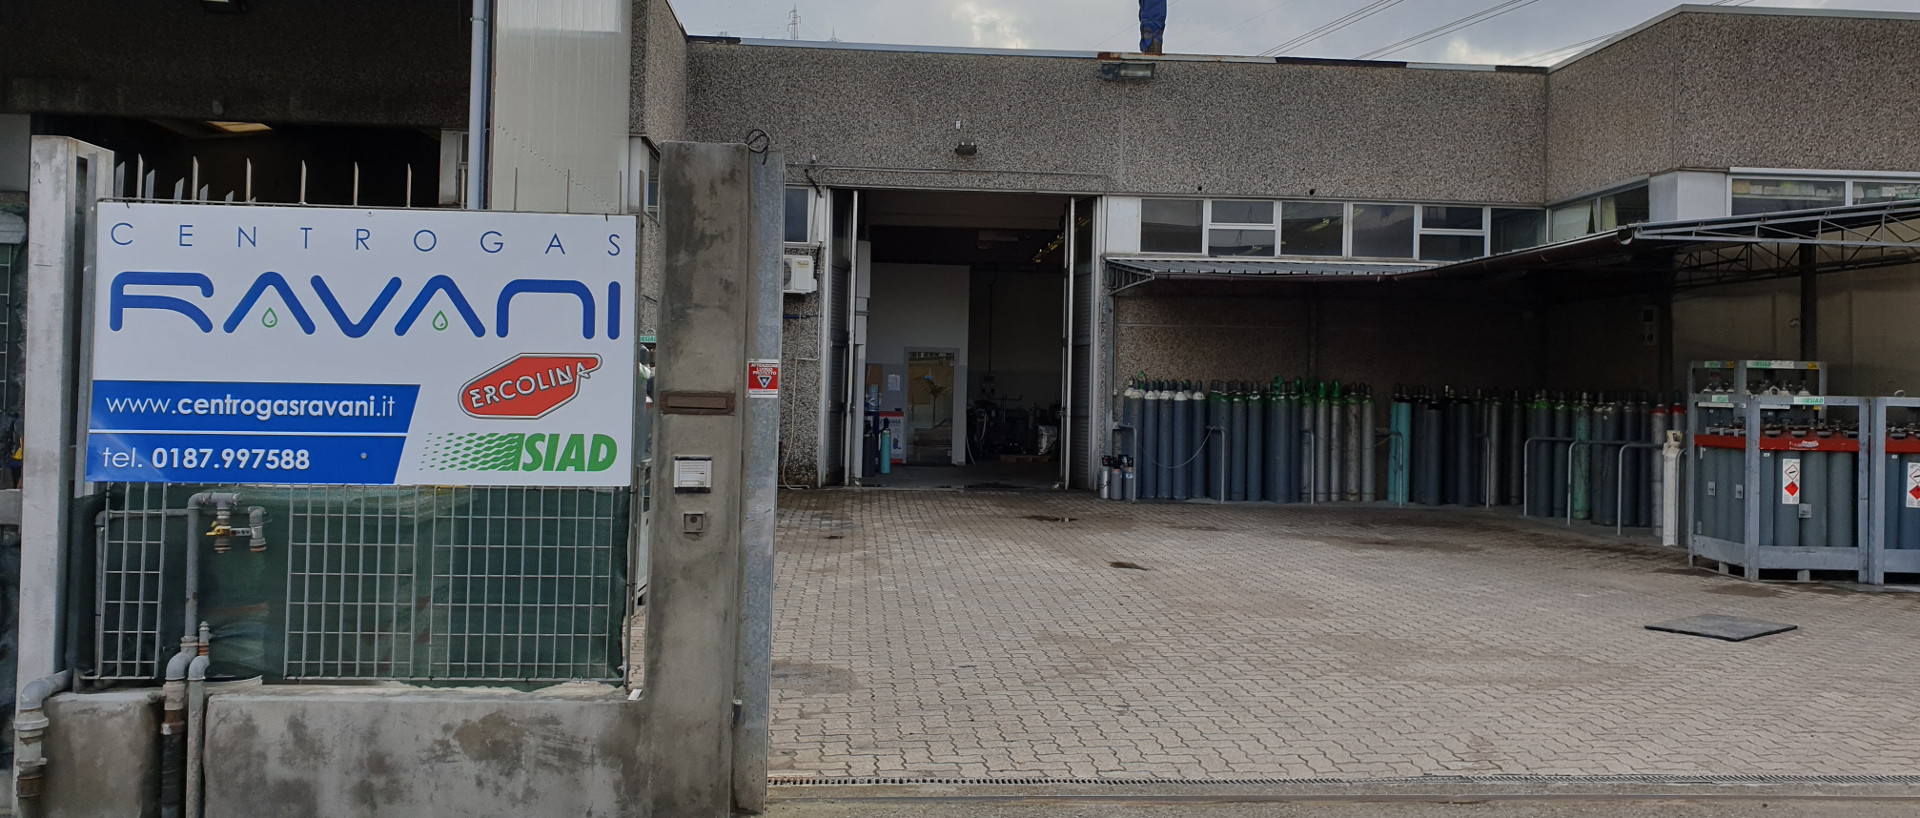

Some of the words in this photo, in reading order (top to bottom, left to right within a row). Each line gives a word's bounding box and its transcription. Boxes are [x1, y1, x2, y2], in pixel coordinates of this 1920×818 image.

[110, 222, 621, 256] CENTROGAS
[109, 271, 621, 340] RAVANI
[468, 361, 591, 409] ERCOLINA
[105, 394, 395, 422] www.centrogasravani.it
[102, 447, 143, 469] tel.
[152, 448, 310, 470] 0187.997588
[521, 433, 618, 473] SIAD
